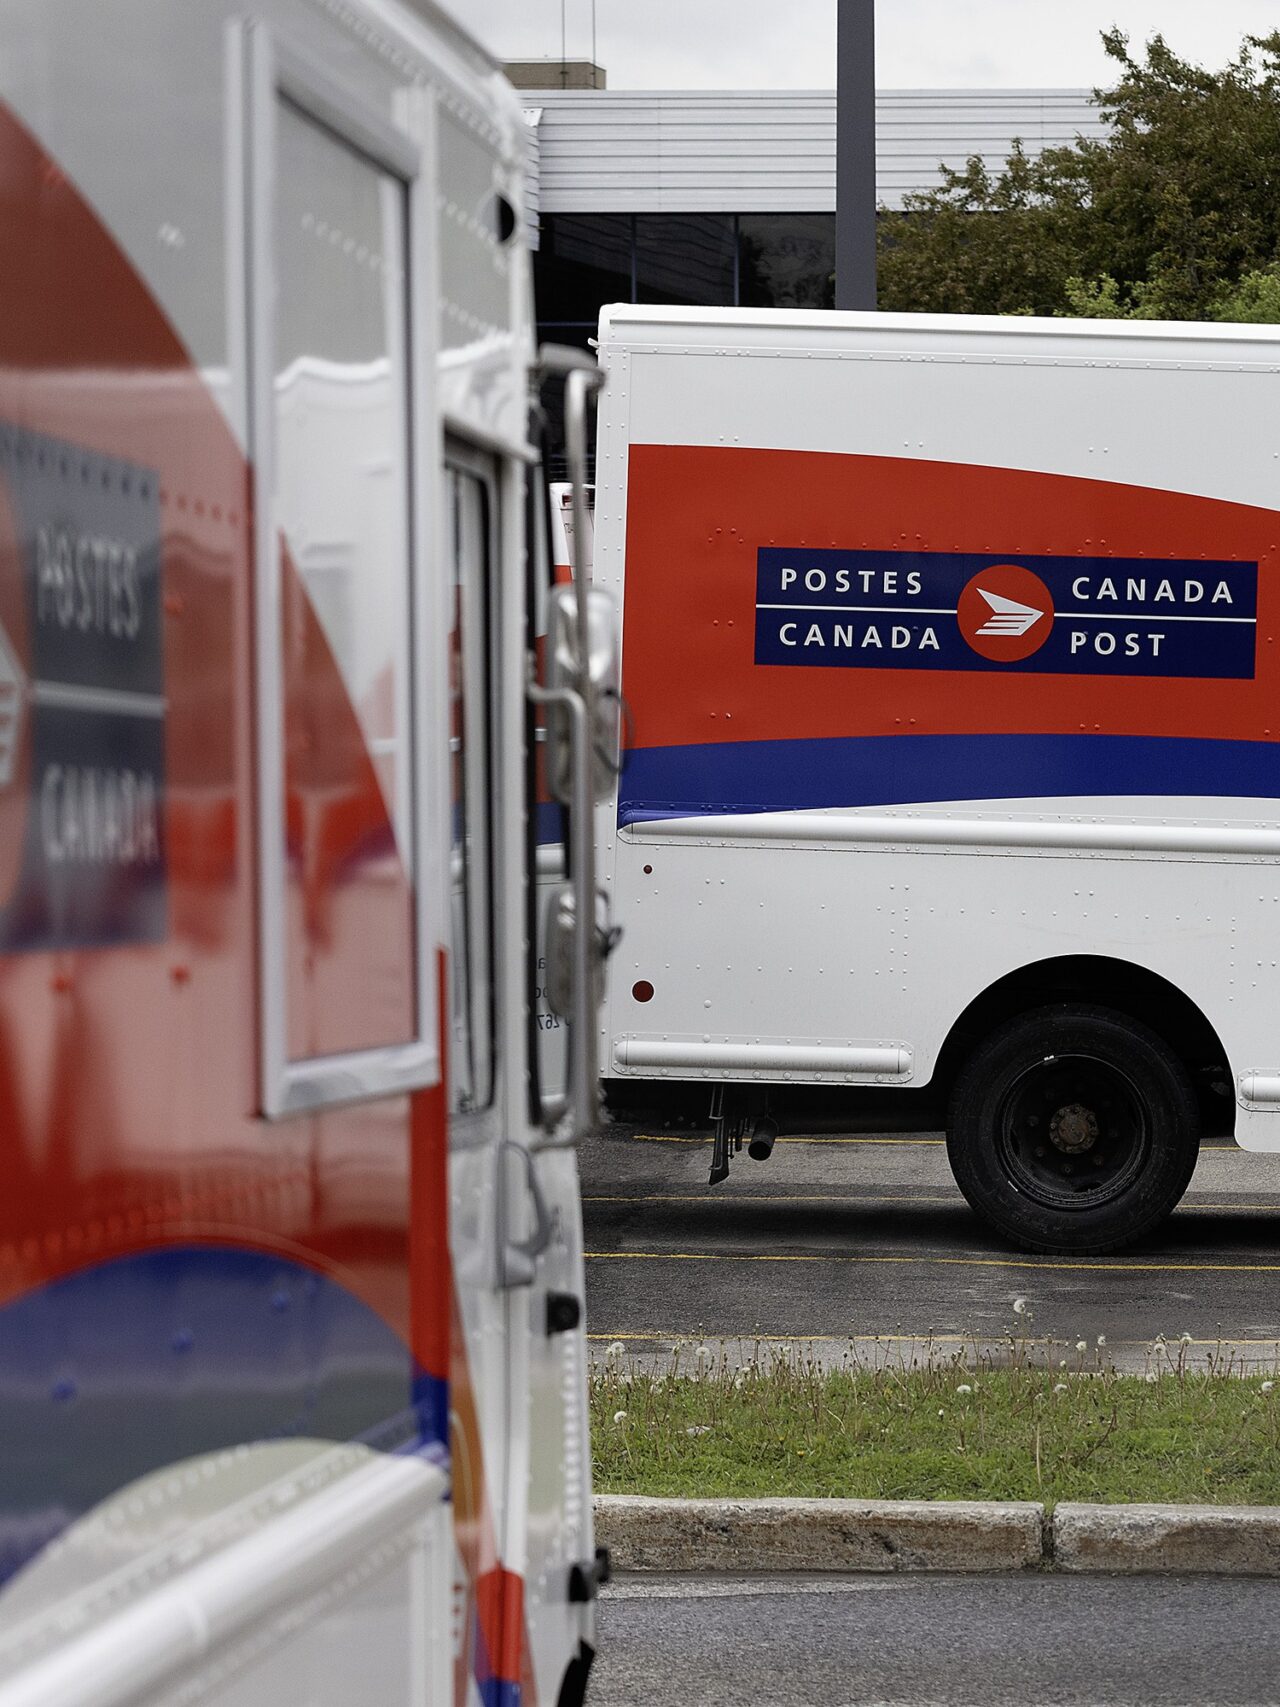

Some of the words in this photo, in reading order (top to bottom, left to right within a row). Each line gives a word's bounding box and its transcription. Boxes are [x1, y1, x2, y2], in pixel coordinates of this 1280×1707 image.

[780, 567, 923, 595] POSTES
[1071, 575, 1234, 605] CANADA
[778, 622, 941, 651] CANADA
[1069, 630, 1166, 658] POST
